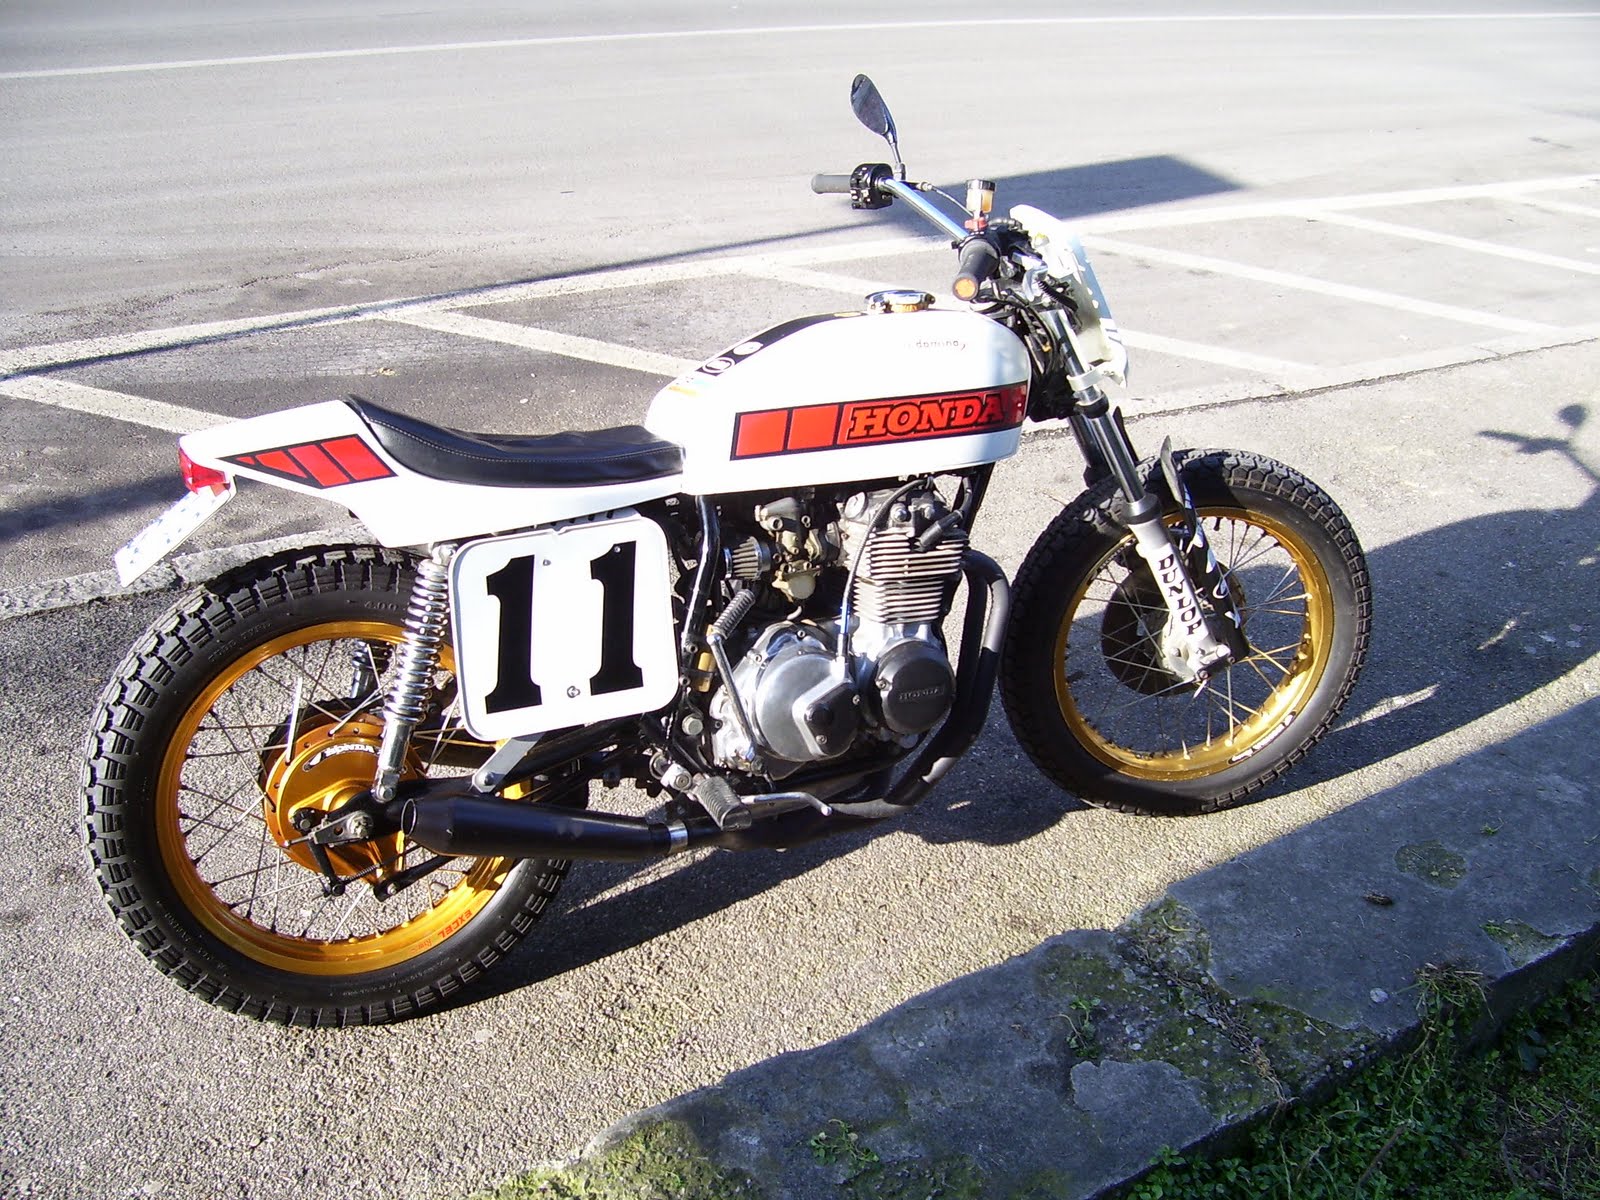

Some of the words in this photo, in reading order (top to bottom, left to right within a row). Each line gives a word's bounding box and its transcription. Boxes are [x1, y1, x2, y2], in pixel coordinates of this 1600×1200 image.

[847, 393, 1004, 441] HONDA
[1157, 553, 1203, 636] DUNLOP
[438, 909, 473, 939] EXCEL
